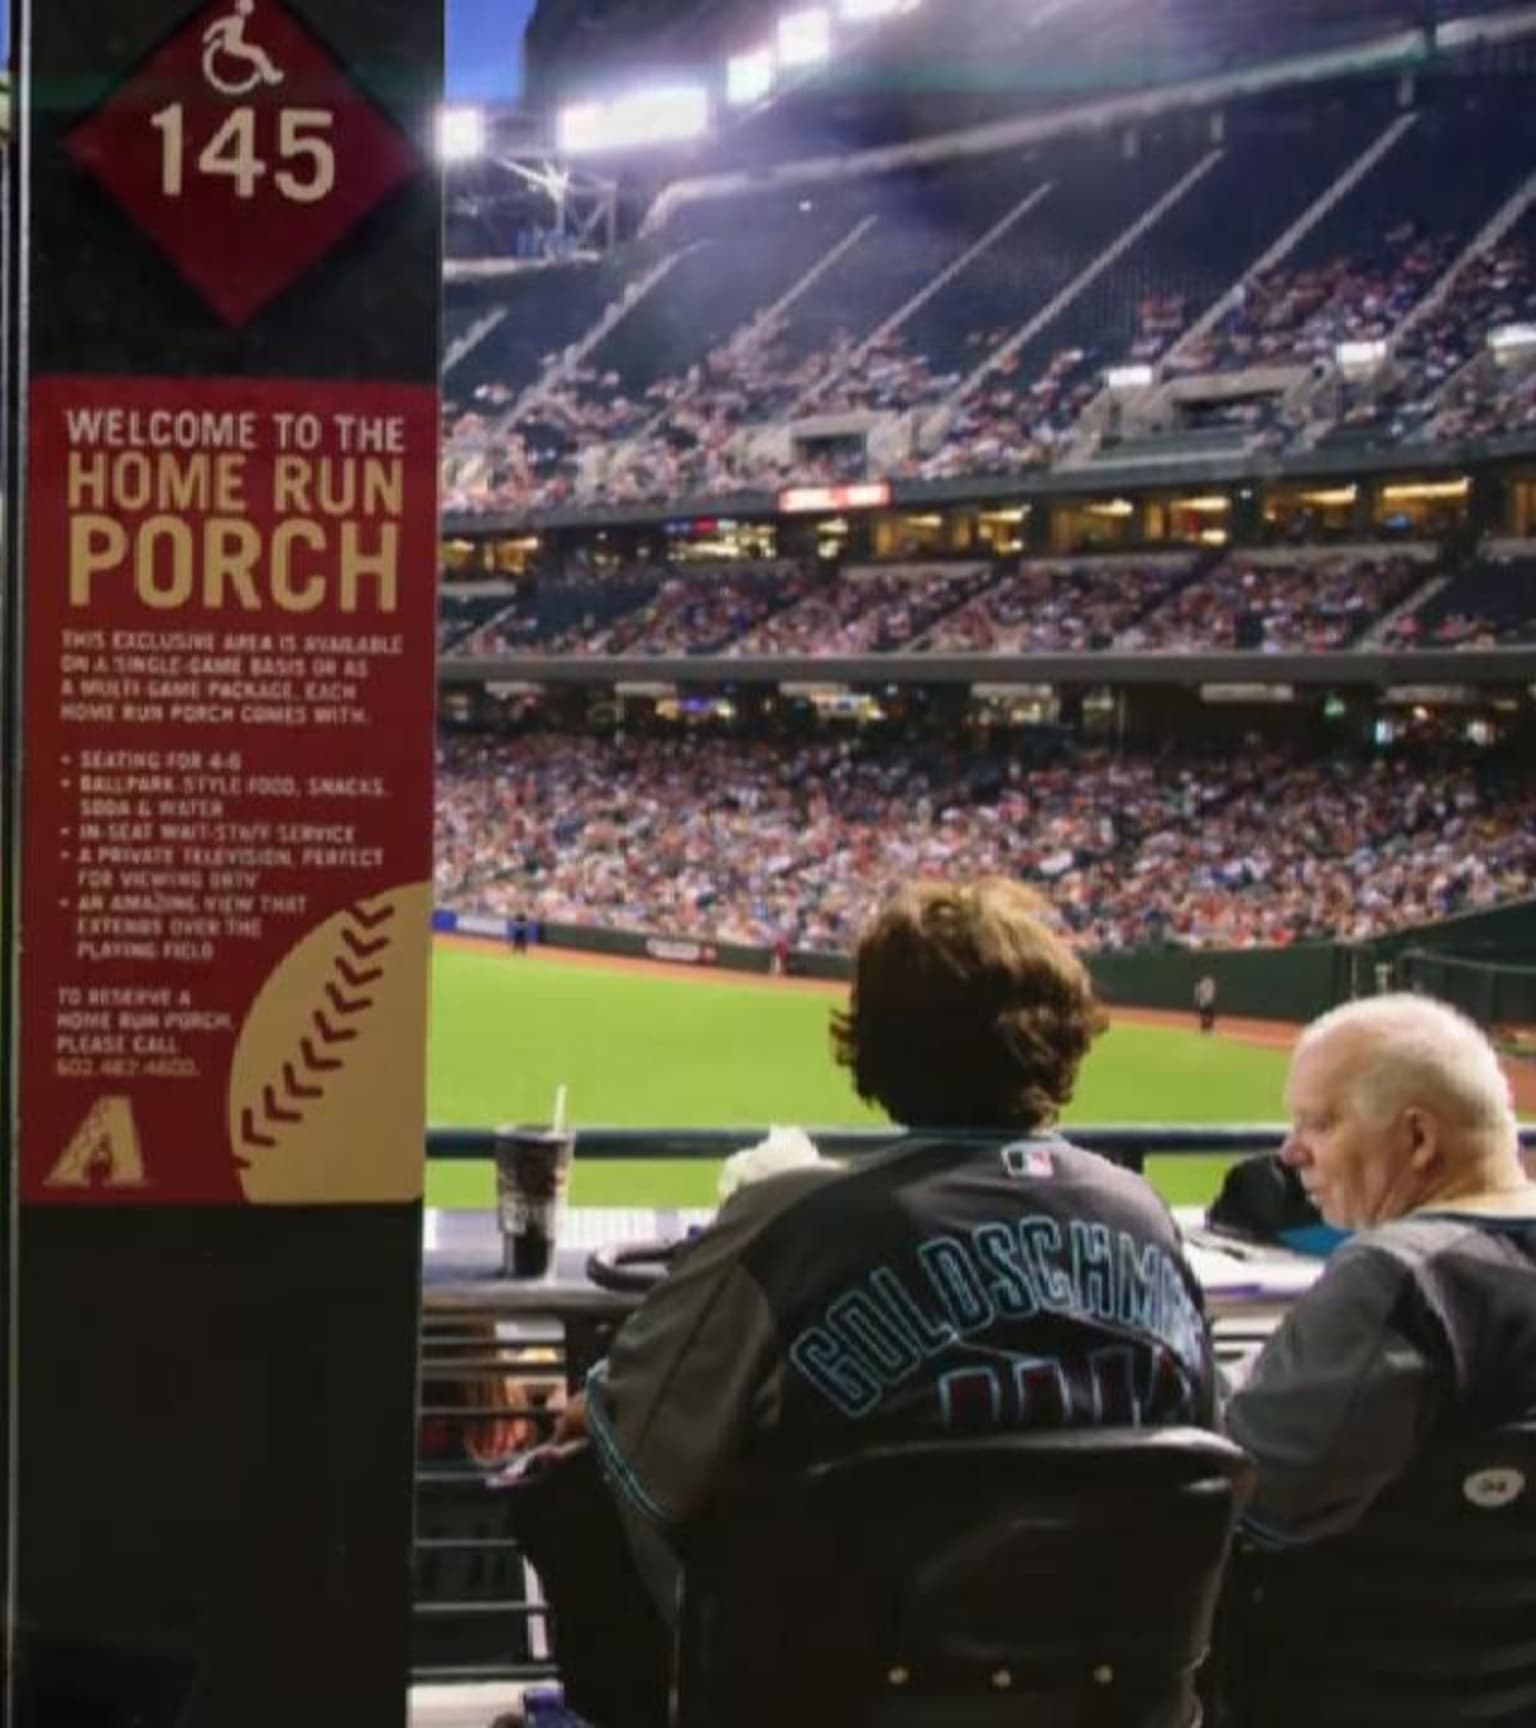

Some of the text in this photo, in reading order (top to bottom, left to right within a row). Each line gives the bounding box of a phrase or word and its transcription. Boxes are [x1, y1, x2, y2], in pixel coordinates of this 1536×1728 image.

[150, 103, 335, 201] 145
[66, 409, 406, 452] WELCOME TO THE
[67, 451, 404, 515] HOME RUN
[68, 513, 399, 612] PORCH
[61, 629, 404, 655] THIS EXCLUSIVE AREA IS AVAILABLE
[61, 654, 90, 673] ON
[250, 657, 305, 677] BASIS
[343, 659, 369, 679] AS
[61, 679, 73, 695] A
[304, 683, 357, 701] EACH
[61, 703, 114, 721] HOME
[122, 704, 163, 723] RUN
[170, 705, 234, 724] PORCH
[241, 706, 306, 725] COMES
[80, 751, 161, 770] SEATING
[167, 752, 202, 771] FOR
[80, 798, 130, 817] SODA
[159, 799, 224, 818] WATER
[277, 825, 355, 844] SERVICE
[78, 847, 92, 864] A
[98, 847, 174, 864] PRIVATE
[302, 848, 384, 868] PERFECT
[78, 870, 114, 889] FOR
[120, 870, 203, 890] VIEWING
[77, 895, 104, 912] AN
[203, 896, 255, 913] VIEW
[260, 896, 307, 915] THAT
[77, 918, 263, 939] EXTENDS OVER THE
[77, 941, 215, 960] PLAYING FIELD
[58, 986, 191, 1006] TO RESERVE A
[57, 1012, 110, 1030] HOME
[119, 1012, 159, 1031] RUN
[57, 1035, 180, 1054] PLEASE CALL
[789, 1215, 1207, 1419] GOLDSCHM
